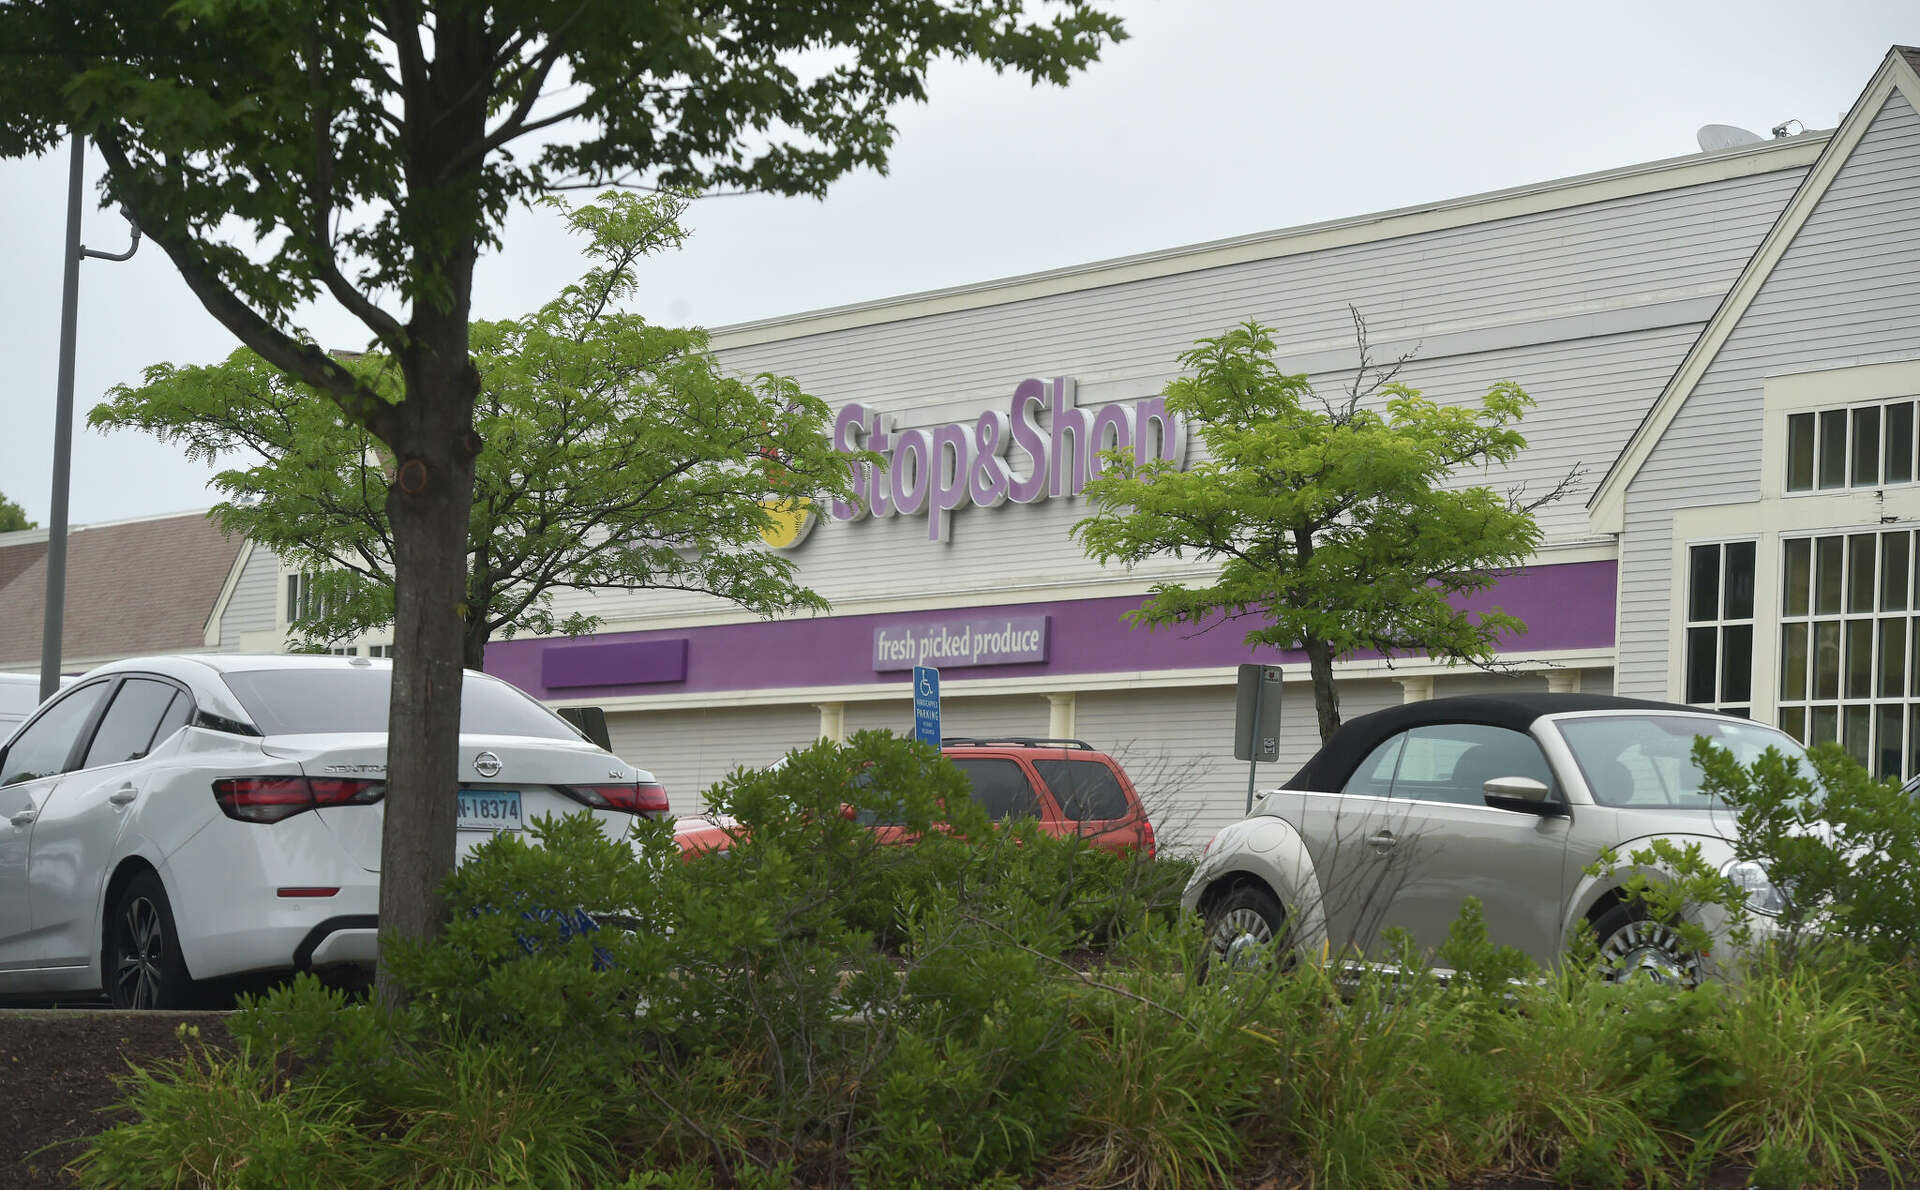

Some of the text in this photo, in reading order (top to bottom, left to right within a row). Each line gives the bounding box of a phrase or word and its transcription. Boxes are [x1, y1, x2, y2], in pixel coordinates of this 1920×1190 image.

[878, 622, 1040, 666] fresh picked produce
[917, 709, 939, 721] PARKING
